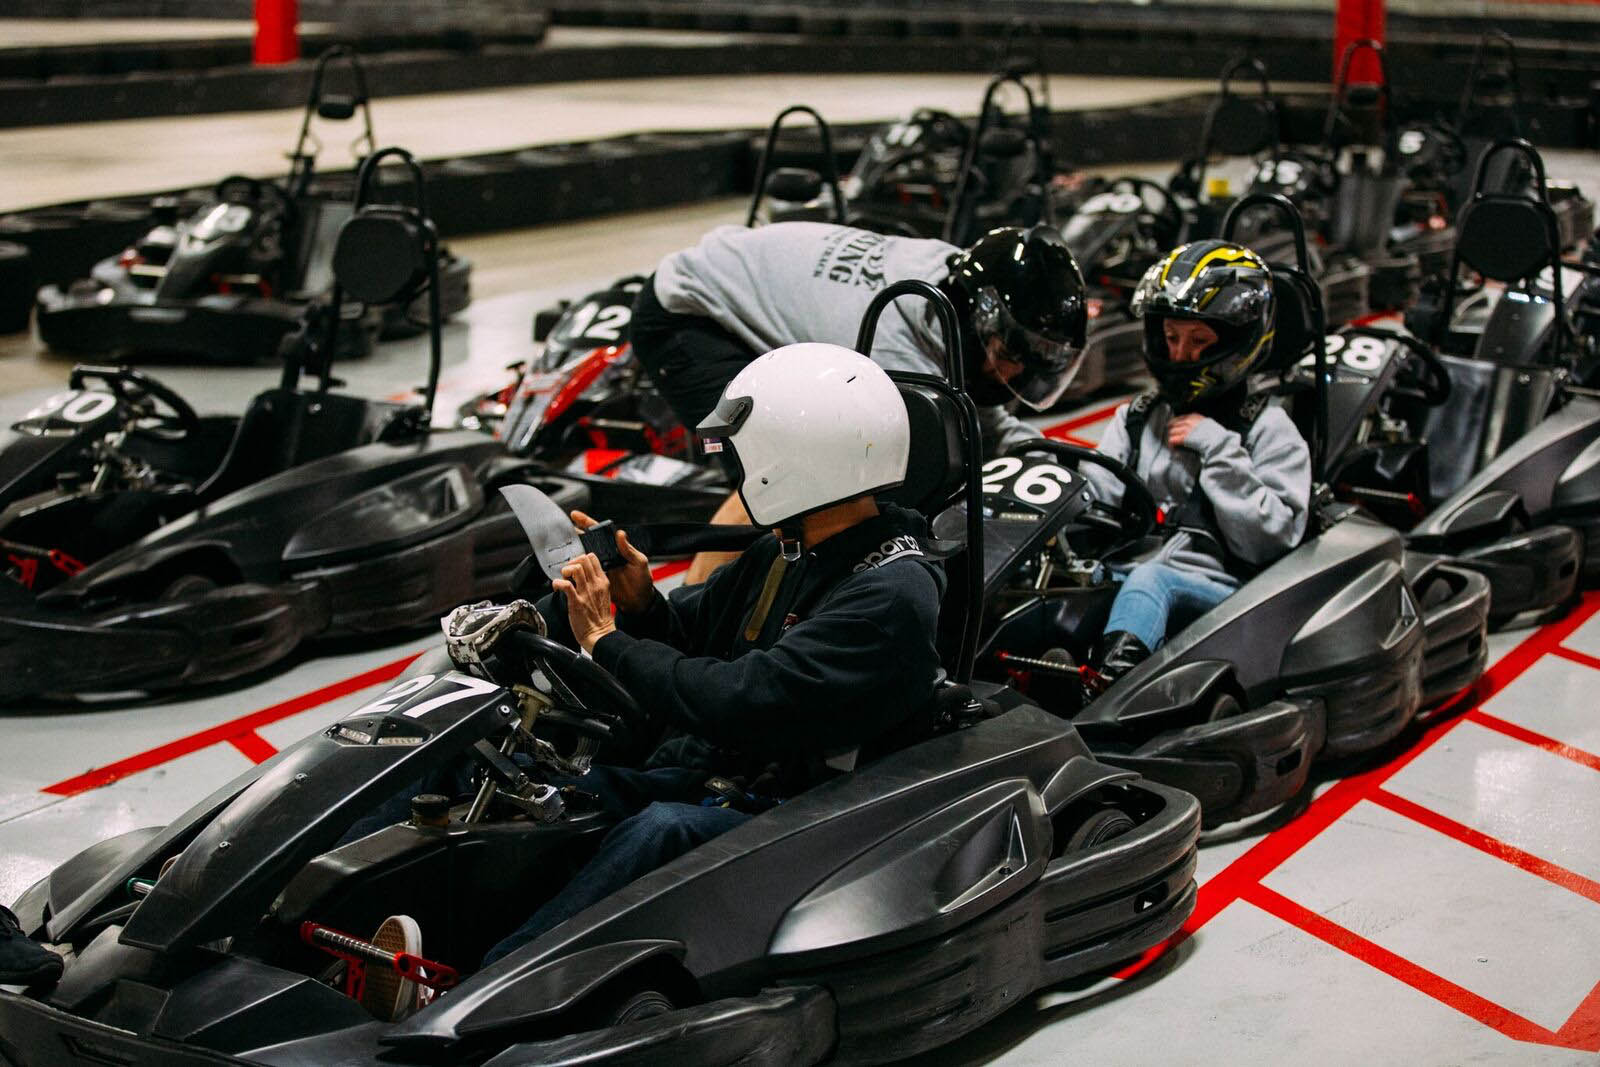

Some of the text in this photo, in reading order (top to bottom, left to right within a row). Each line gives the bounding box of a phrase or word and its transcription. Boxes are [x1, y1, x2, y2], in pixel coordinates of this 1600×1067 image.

[569, 302, 632, 340] 12
[981, 457, 1072, 504] 26
[349, 673, 501, 719] 27
